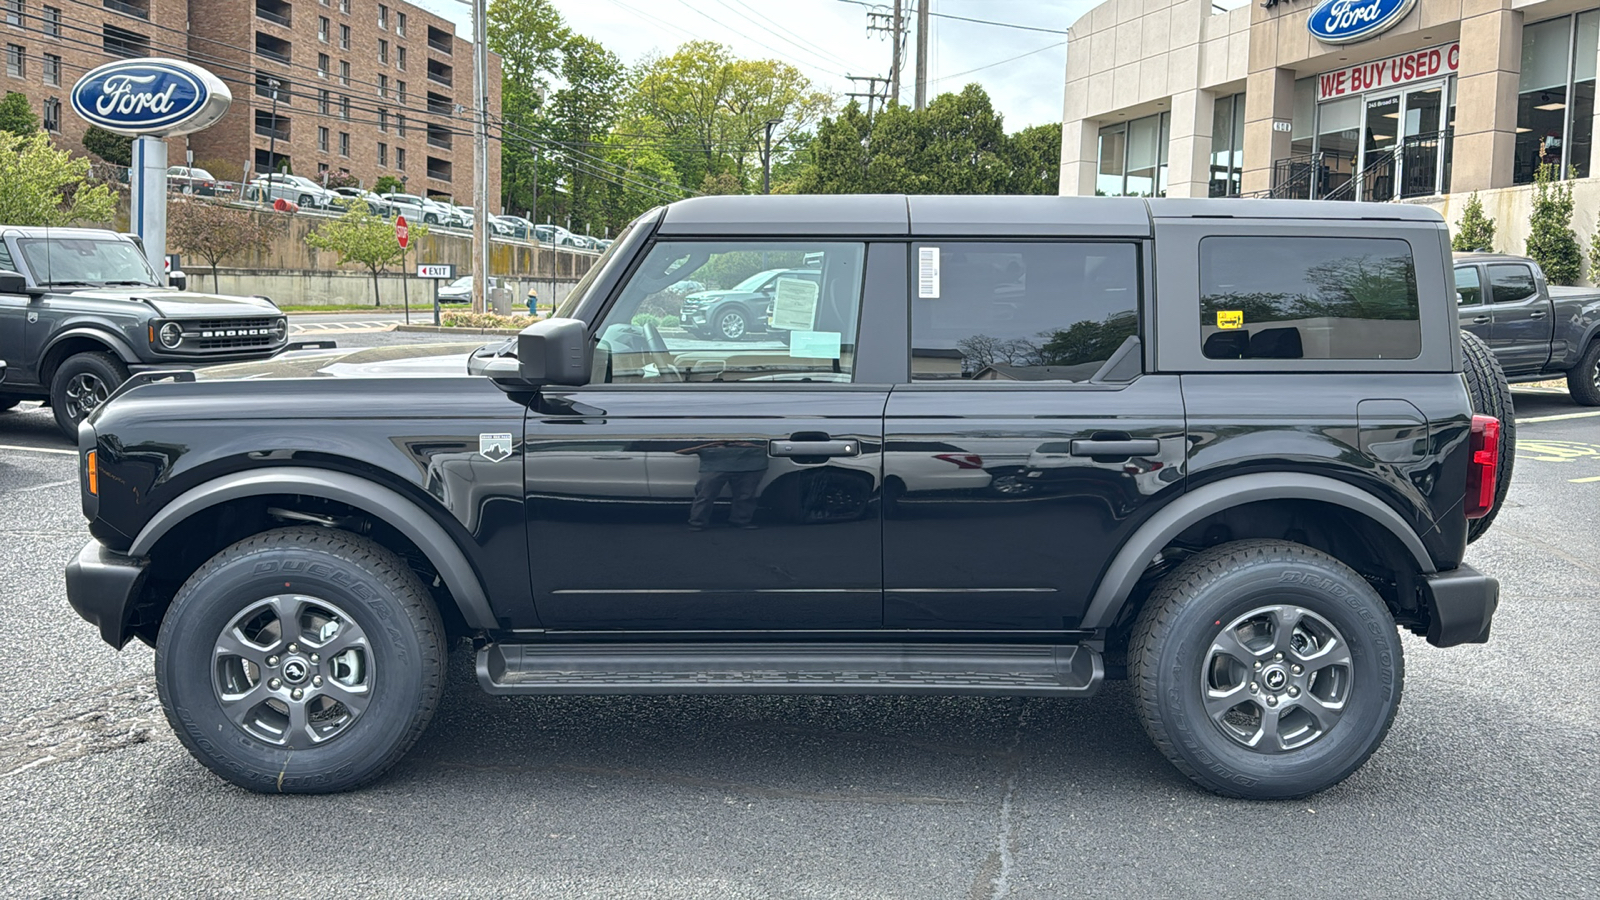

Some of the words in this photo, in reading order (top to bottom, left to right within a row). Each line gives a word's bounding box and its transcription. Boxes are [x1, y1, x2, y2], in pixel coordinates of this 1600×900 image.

[1325, 0, 1382, 33] Ford
[1321, 71, 1347, 98] WE
[1351, 61, 1387, 92] BUY
[1391, 49, 1441, 83] USED
[96, 74, 178, 116] Ford
[396, 225, 408, 239] STOP
[428, 267, 447, 276] EXIT
[202, 329, 269, 338] BRONCO
[253, 559, 393, 620] DUELER
[1166, 686, 1260, 788] DUELER
